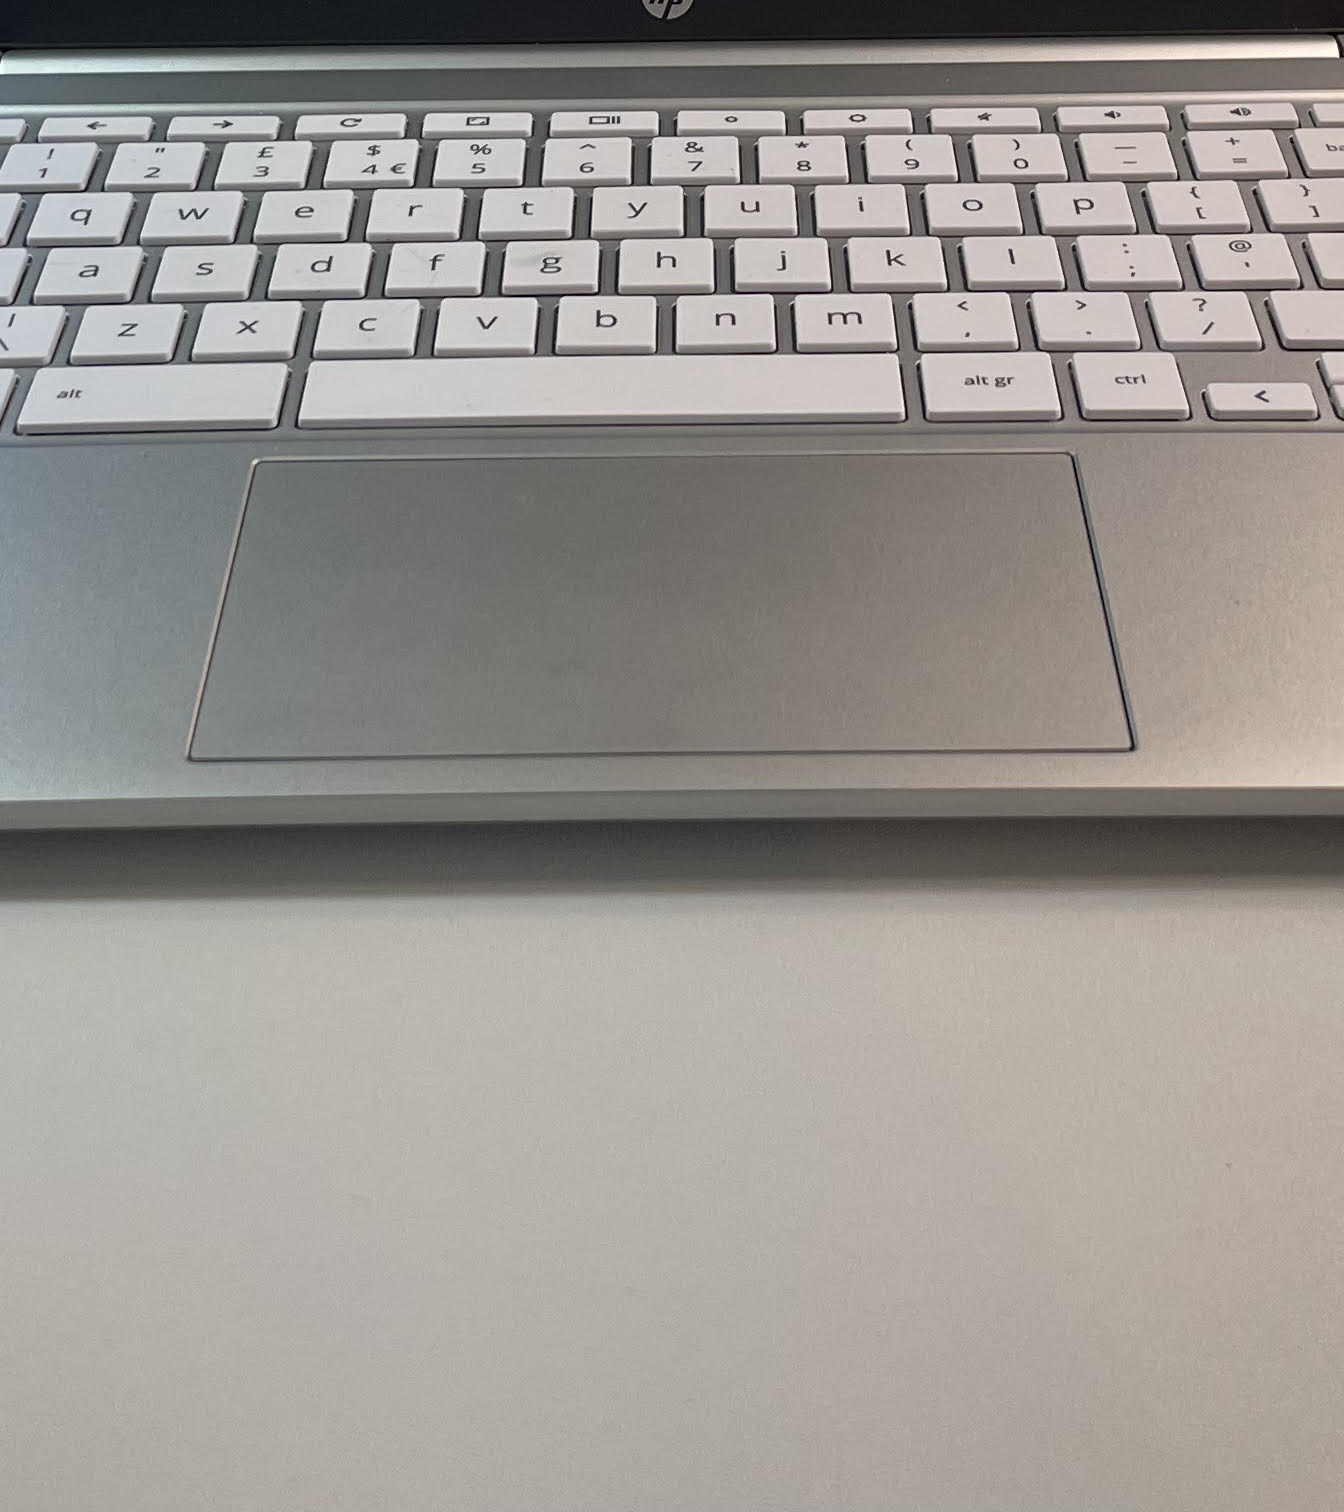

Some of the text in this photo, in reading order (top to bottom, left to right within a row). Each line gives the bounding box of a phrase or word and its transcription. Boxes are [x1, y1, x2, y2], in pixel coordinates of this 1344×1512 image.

[361, 163, 378, 175] 4
[471, 163, 486, 175] 5
[579, 161, 594, 173] 6
[688, 160, 703, 173] 7
[796, 160, 812, 172] 8
[904, 157, 920, 170] 9
[1012, 157, 1029, 170] 0
[144, 166, 160, 178] 2
[254, 165, 271, 178] 3
[294, 204, 315, 220] e
[627, 200, 647, 219] y
[741, 198, 759, 214] u
[1073, 197, 1094, 215] p
[70, 206, 92, 226] q
[311, 254, 333, 274] d
[429, 253, 446, 273] f
[540, 255, 562, 275] g
[656, 250, 677, 269] h
[886, 249, 907, 267] k
[78, 263, 100, 278] a
[596, 309, 617, 329] b
[715, 311, 736, 327] n
[827, 310, 863, 326] m
[964, 373, 1015, 388] alt gr
[1114, 373, 1146, 385] ctrl
[56, 388, 82, 399] alt
